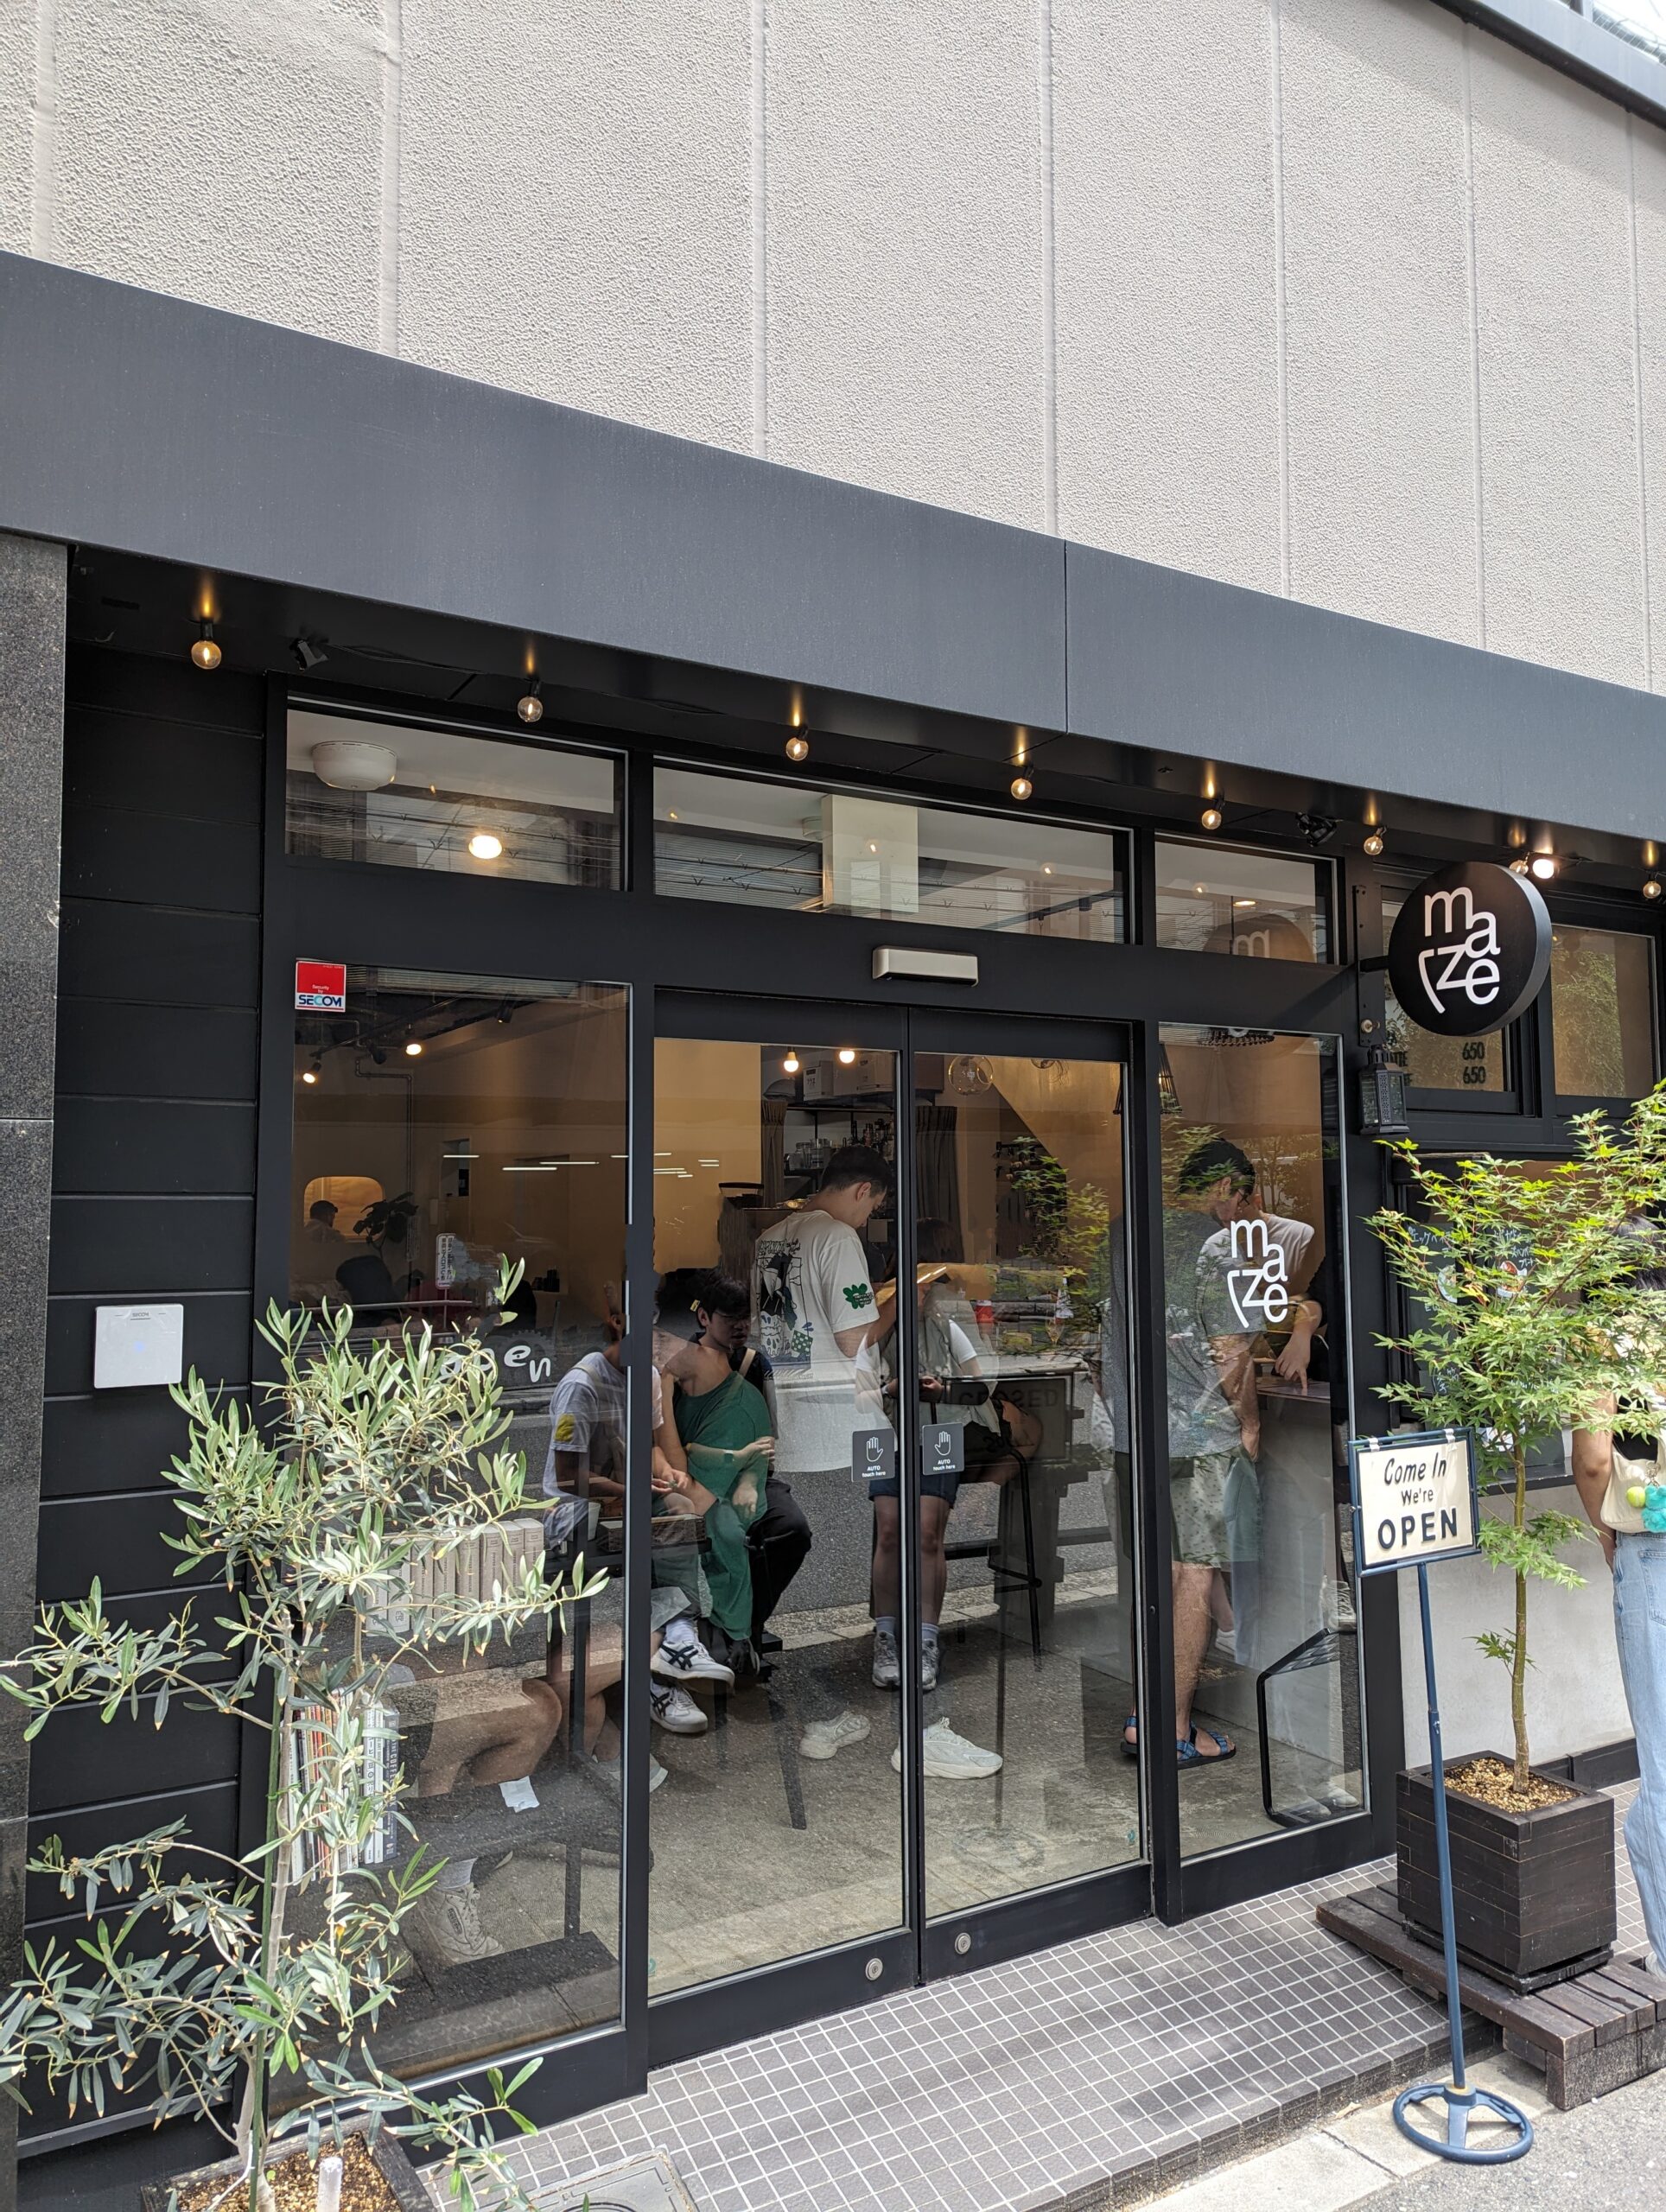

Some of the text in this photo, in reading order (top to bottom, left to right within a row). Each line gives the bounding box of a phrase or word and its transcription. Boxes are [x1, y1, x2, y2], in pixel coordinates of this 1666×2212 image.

[1418, 887, 1501, 1014] maze
[298, 995, 342, 1007] SECOM
[1461, 1041, 1485, 1060] 650
[1462, 1066, 1486, 1084] 650
[1227, 1218, 1288, 1328] maze
[1383, 1452, 1447, 1486] Come In
[1401, 1488, 1434, 1507] We're
[1377, 1507, 1458, 1550] OPEN
